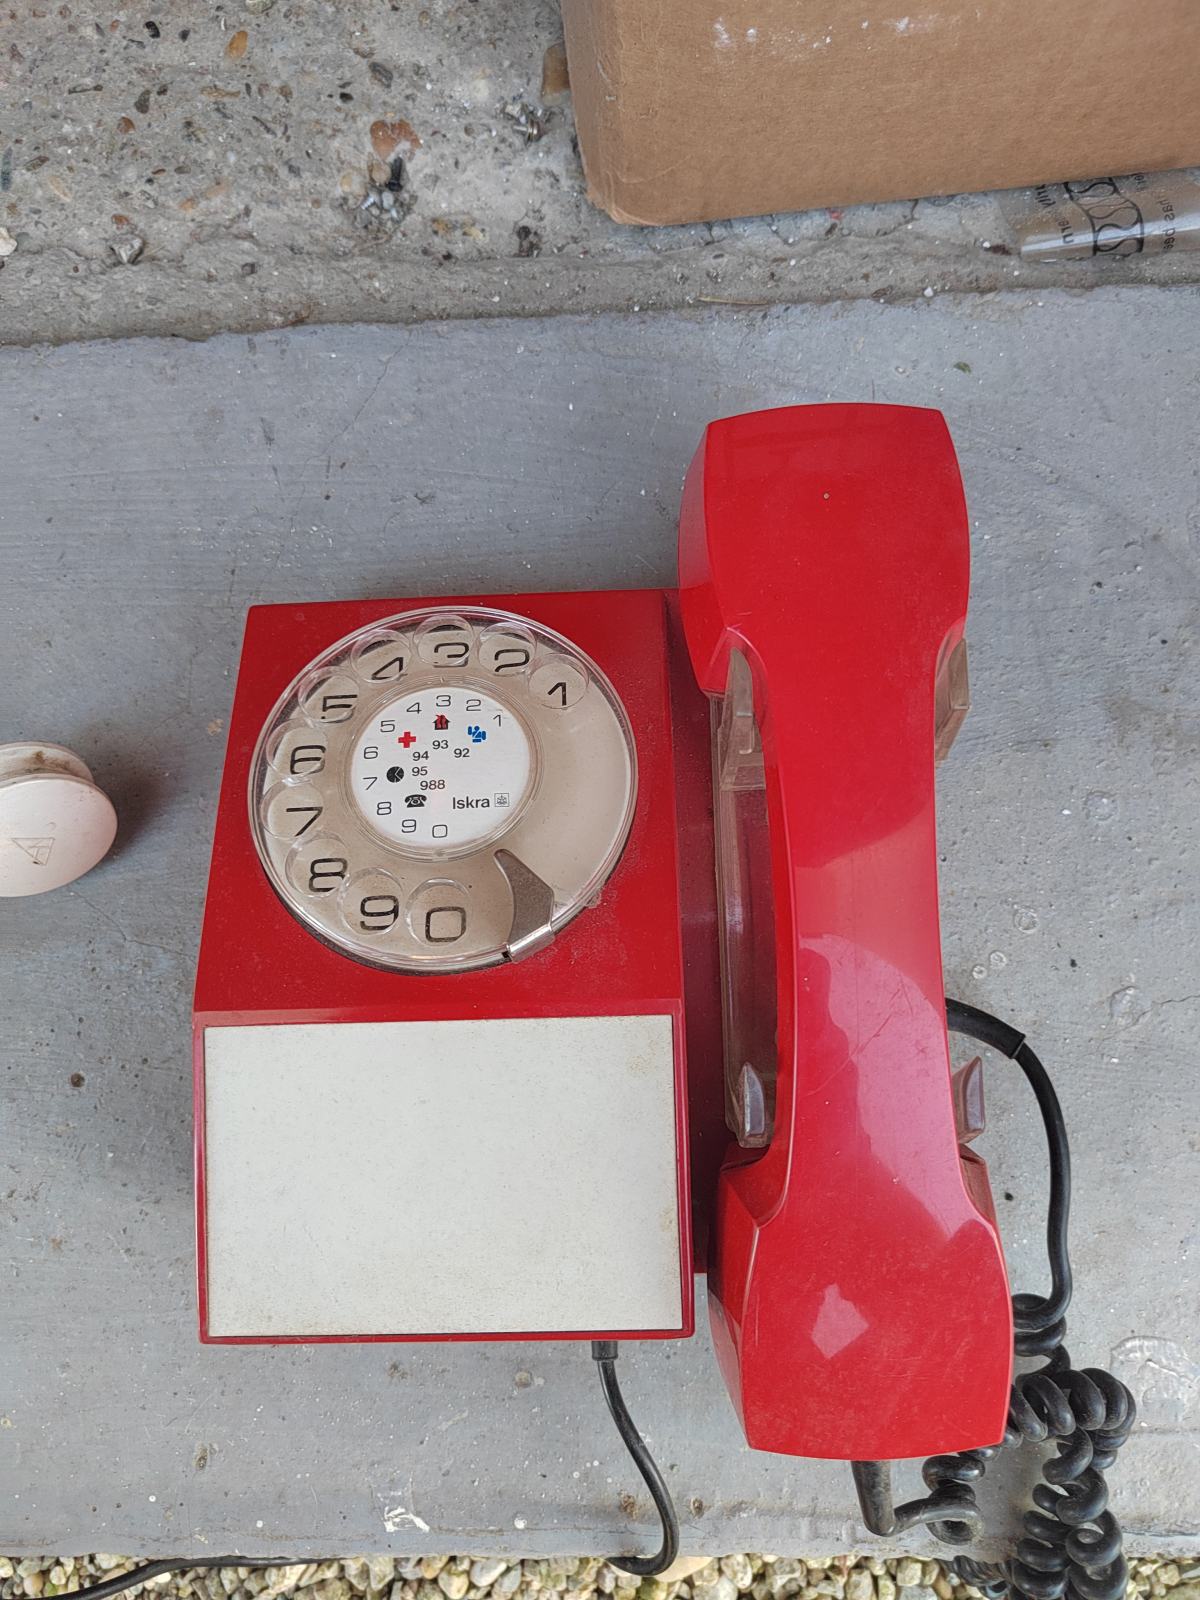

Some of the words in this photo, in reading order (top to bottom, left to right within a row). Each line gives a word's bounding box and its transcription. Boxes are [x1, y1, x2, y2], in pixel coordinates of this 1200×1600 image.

[434, 642, 469, 668] 3
[494, 649, 530, 673] 2
[371, 657, 407, 680] 4
[547, 682, 567, 706] 1
[436, 695, 451, 707] 3
[466, 699, 481, 711] 2
[321, 694, 357, 724] 5
[406, 703, 422, 714] 4
[380, 720, 396, 732] 5
[493, 715, 502, 727] 1
[432, 740, 449, 750] 93
[290, 745, 326, 774] 6
[364, 747, 378, 759] 6
[412, 751, 429, 761] 94
[454, 748, 470, 758] 92
[412, 766, 428, 776] 95
[363, 777, 377, 790] 7
[420, 780, 445, 790] 988
[377, 802, 392, 815] 8
[452, 796, 490, 809] Iskra
[286, 806, 323, 837] 7
[402, 819, 416, 833] 9
[309, 858, 347, 893] 8
[360, 895, 399, 930] 9
[425, 906, 466, 942] 0
